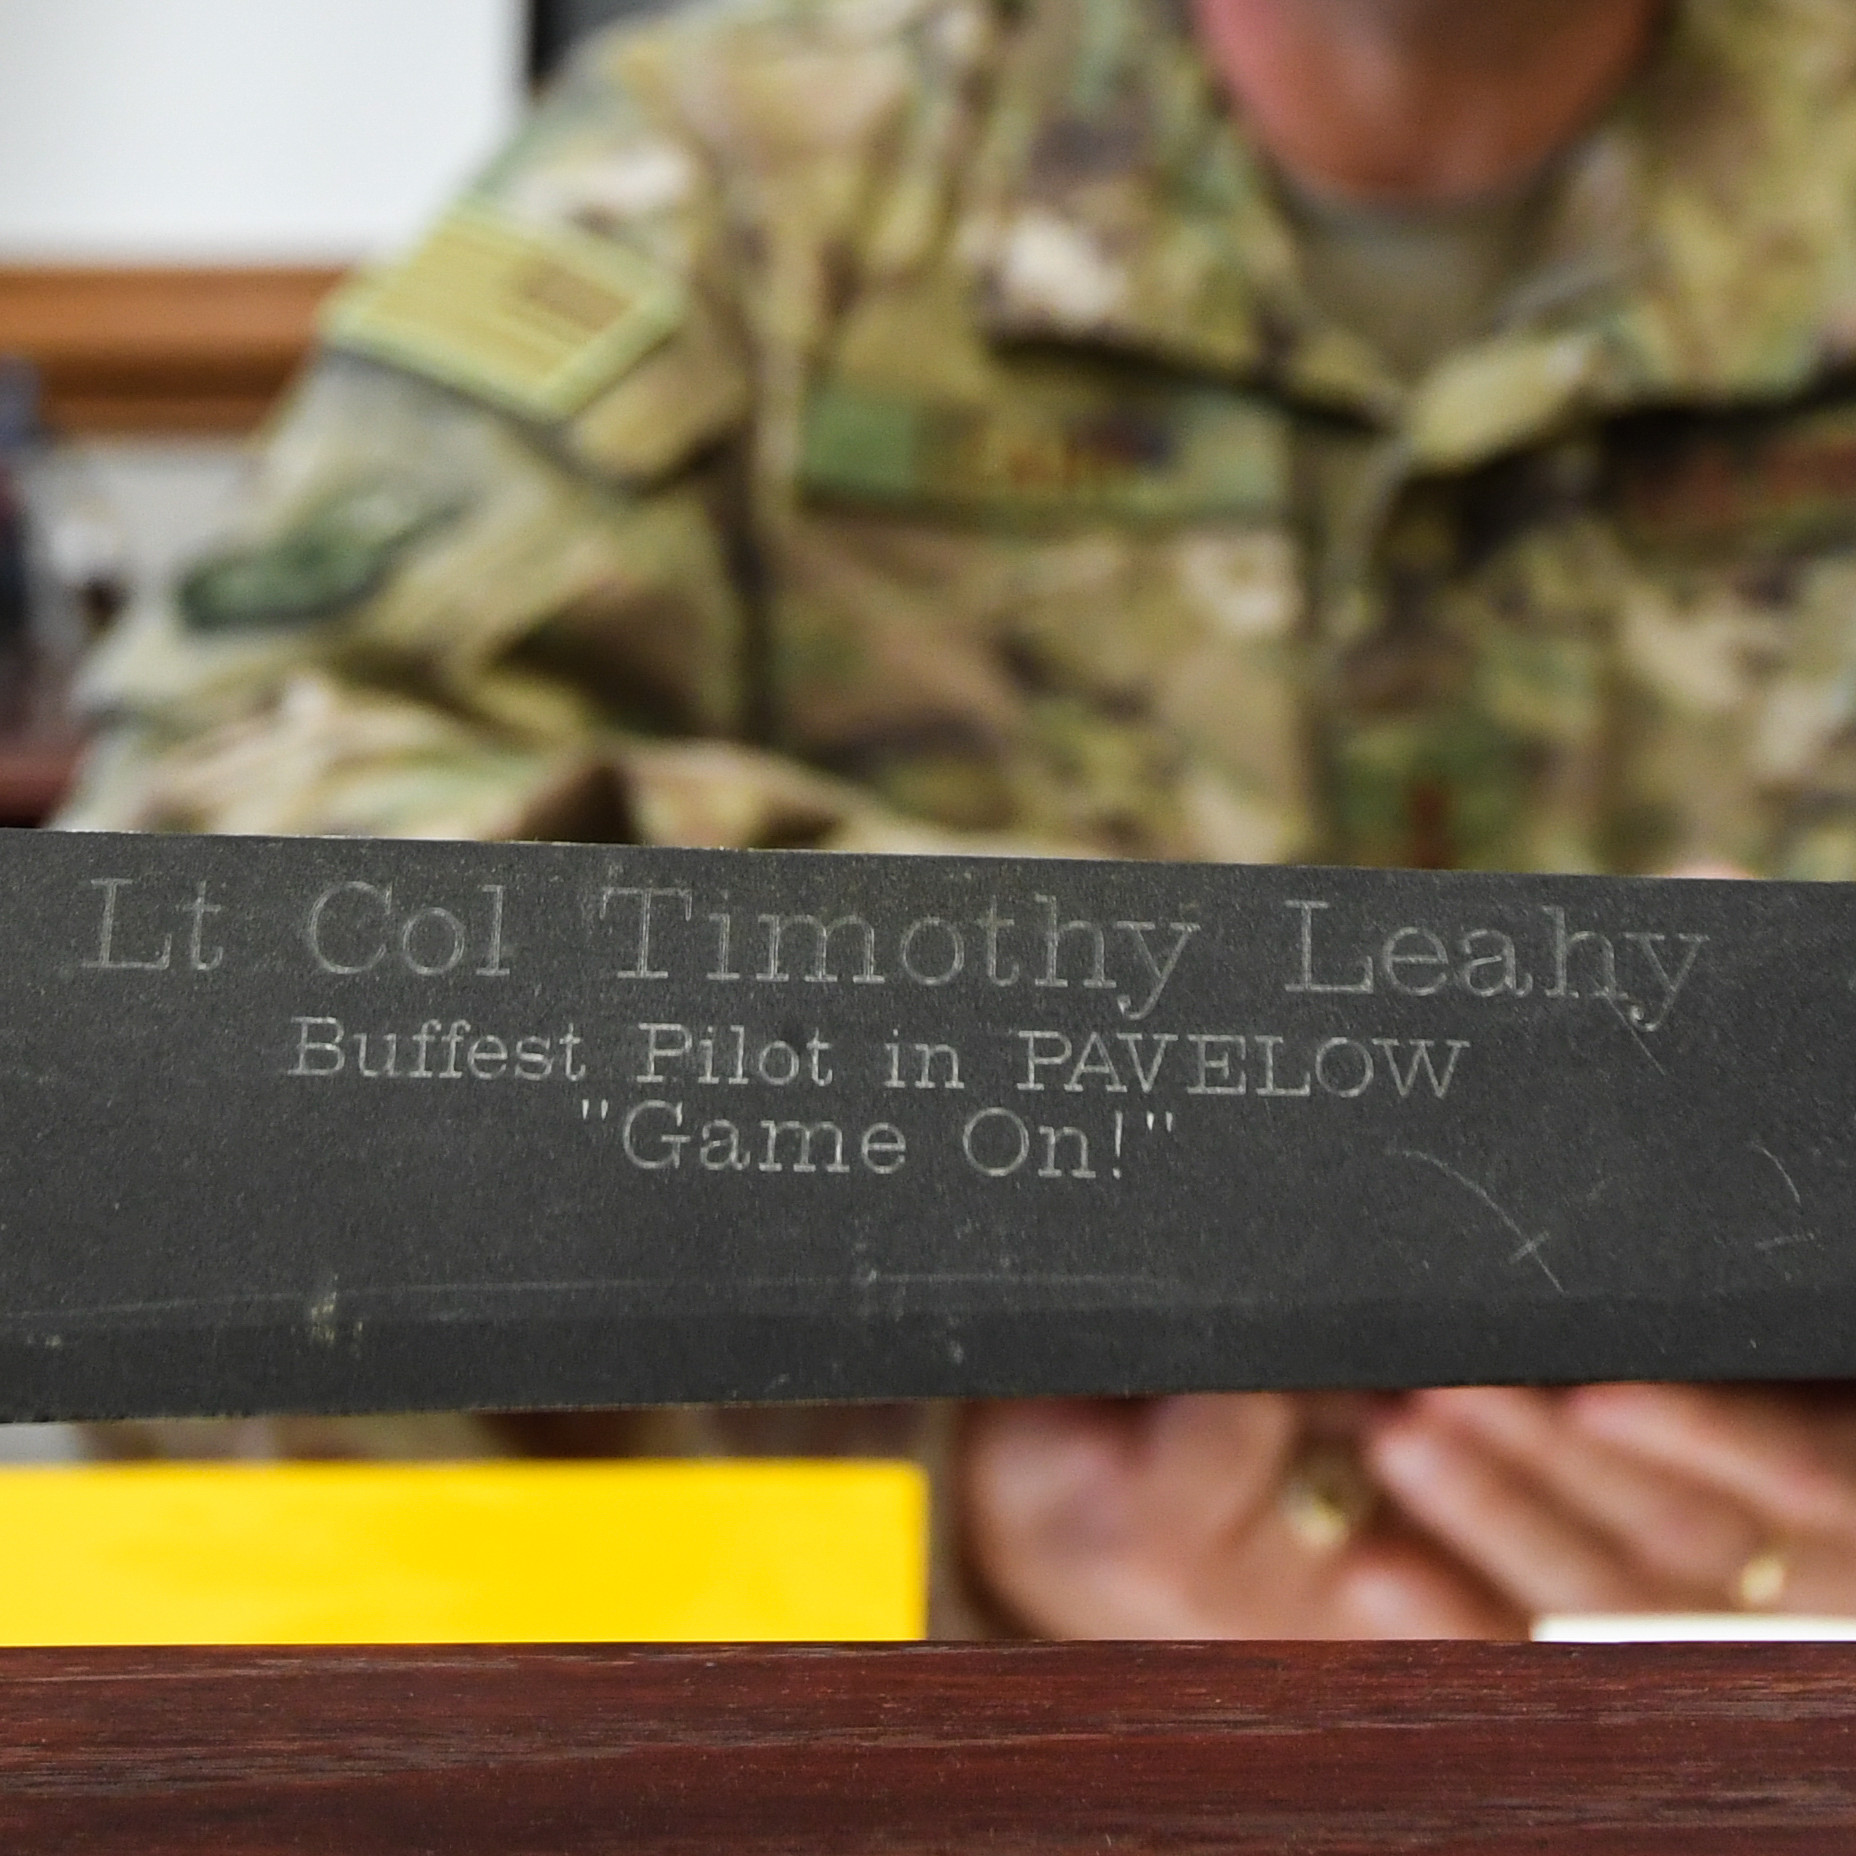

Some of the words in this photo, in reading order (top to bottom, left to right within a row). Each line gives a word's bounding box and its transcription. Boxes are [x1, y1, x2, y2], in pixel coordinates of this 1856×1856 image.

[80, 876, 223, 973] Lt
[304, 879, 511, 977] Col
[598, 881, 1202, 1021] Timothy
[1283, 898, 1711, 1033] Leahy
[285, 1015, 588, 1081] Buffest
[635, 1021, 835, 1087] Pilot
[883, 1028, 966, 1091] in
[1015, 1029, 1471, 1099] PAVELOW
[579, 1097, 908, 1175] "Game
[961, 1106, 1175, 1180] On!"
